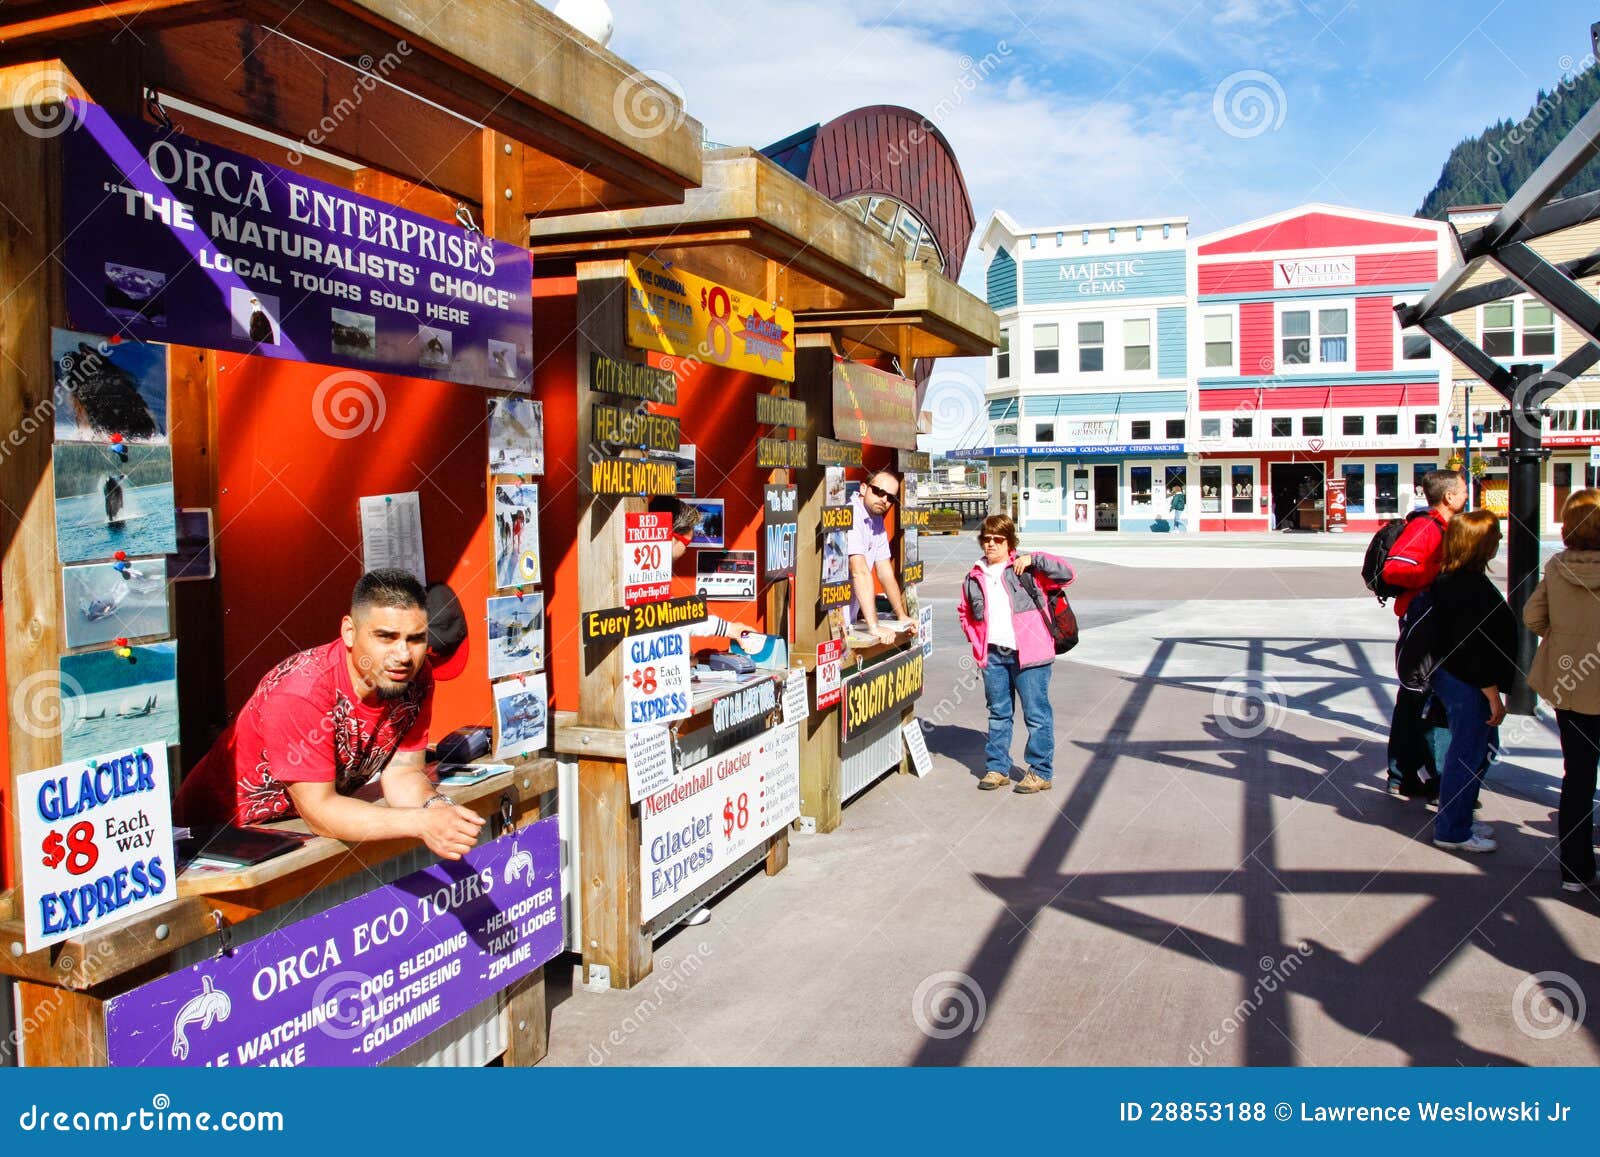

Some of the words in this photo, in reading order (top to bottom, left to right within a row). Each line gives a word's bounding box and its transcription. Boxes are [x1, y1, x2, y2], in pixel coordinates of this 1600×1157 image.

[148, 140, 272, 214] ORCA
[288, 182, 496, 277] ENTERPRISES
[638, 268, 652, 286] THE
[1059, 259, 1144, 282] MAJESTIC
[1279, 263, 1350, 285] VENETIAN
[1297, 275, 1350, 284] JEWELERS
[199, 249, 282, 284] LOCAL
[290, 270, 362, 302] TOURS
[370, 290, 420, 315] SOLD
[426, 303, 470, 326] HERE
[1078, 281, 1126, 294] GEMS
[630, 287, 665, 319] BLUE
[667, 299, 694, 327] BUS
[701, 286, 733, 363] $8
[745, 315, 782, 341] GLACIER
[744, 336, 785, 362] EXPRESS
[596, 357, 617, 392] CITY
[597, 408, 677, 450] HELICOPTERS
[759, 441, 787, 465] SALMON
[789, 442, 807, 466] BAKE
[1032, 446, 1045, 454] BLUE
[1154, 444, 1180, 452] WATCHES
[592, 461, 631, 494] WHALE
[632, 461, 677, 496] WATCHING
[638, 515, 658, 527] RED
[823, 510, 835, 527] DOG
[836, 508, 852, 526] SLED
[628, 526, 668, 541] TROLLEY
[767, 523, 797, 571] MGT
[633, 544, 661, 571] $20
[627, 573, 640, 584] ALL
[823, 584, 851, 604] FISHING
[589, 613, 631, 638] Every
[635, 605, 656, 629] 30
[657, 602, 706, 623] Minutes
[631, 633, 684, 664] GLACIER
[632, 666, 658, 695] $8
[660, 666, 681, 678] Each
[665, 676, 683, 687] way
[822, 663, 836, 682] $20
[631, 692, 688, 723] EXPRESS
[849, 683, 868, 733] $30
[868, 673, 887, 717] CITY
[895, 655, 923, 703] GLACIER
[630, 738, 646, 750] WHALE
[37, 752, 156, 823] GLACIER
[645, 769, 714, 819] Mendenhall
[717, 750, 752, 780] Glacier
[105, 809, 150, 838] Each
[722, 792, 749, 841] $8
[41, 820, 99, 876] $8
[116, 829, 155, 853] way
[650, 812, 713, 865] Glacier
[651, 841, 714, 899] Express
[39, 856, 167, 938] EXPRESS
[252, 938, 341, 1001] ORCA
[353, 906, 409, 952] ECO
[418, 867, 495, 926] TOURS
[522, 906, 557, 938] LODGE
[399, 931, 468, 981] SLEDDING
[237, 999, 339, 1061] WATCHING
[259, 1043, 306, 1067] AKE
